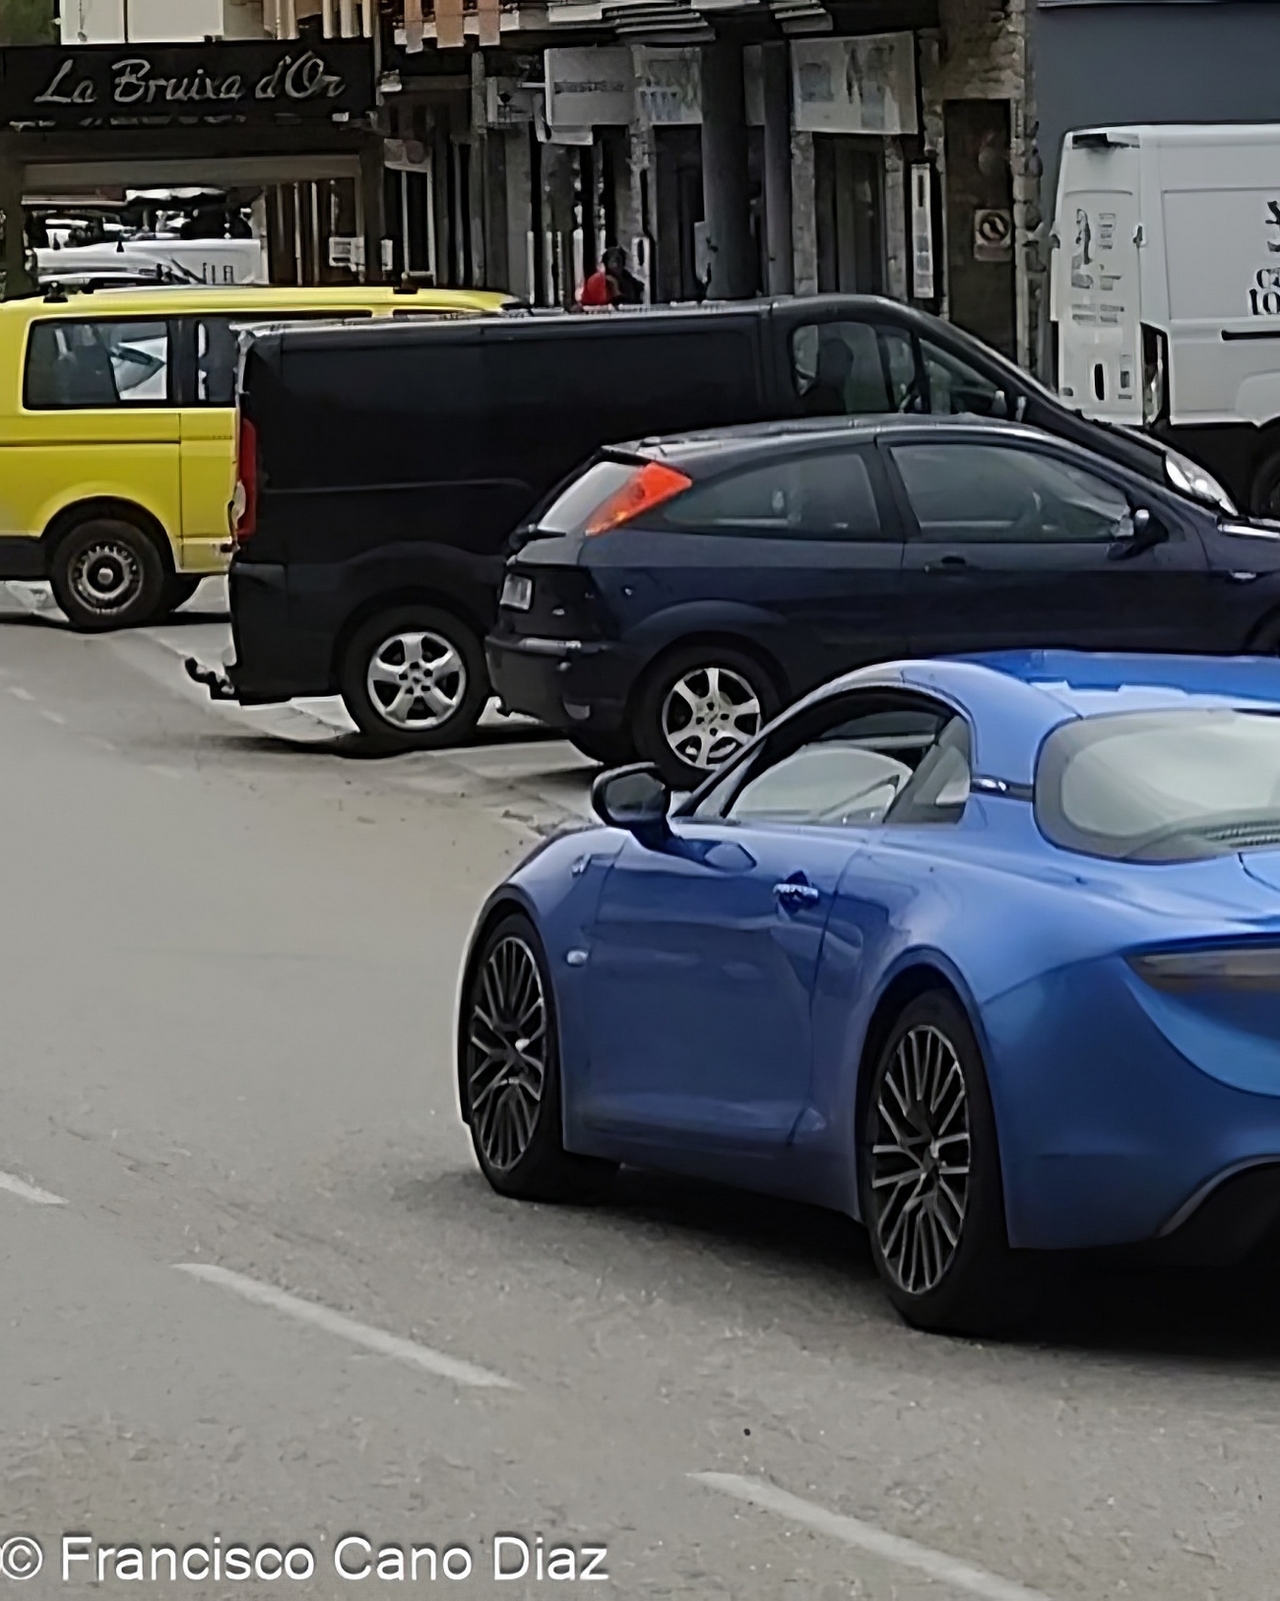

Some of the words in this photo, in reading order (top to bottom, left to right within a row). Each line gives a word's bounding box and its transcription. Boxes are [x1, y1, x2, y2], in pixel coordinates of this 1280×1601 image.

[34, 59, 97, 103] La
[111, 58, 246, 103] Bruixa
[255, 50, 346, 99] d'Or
